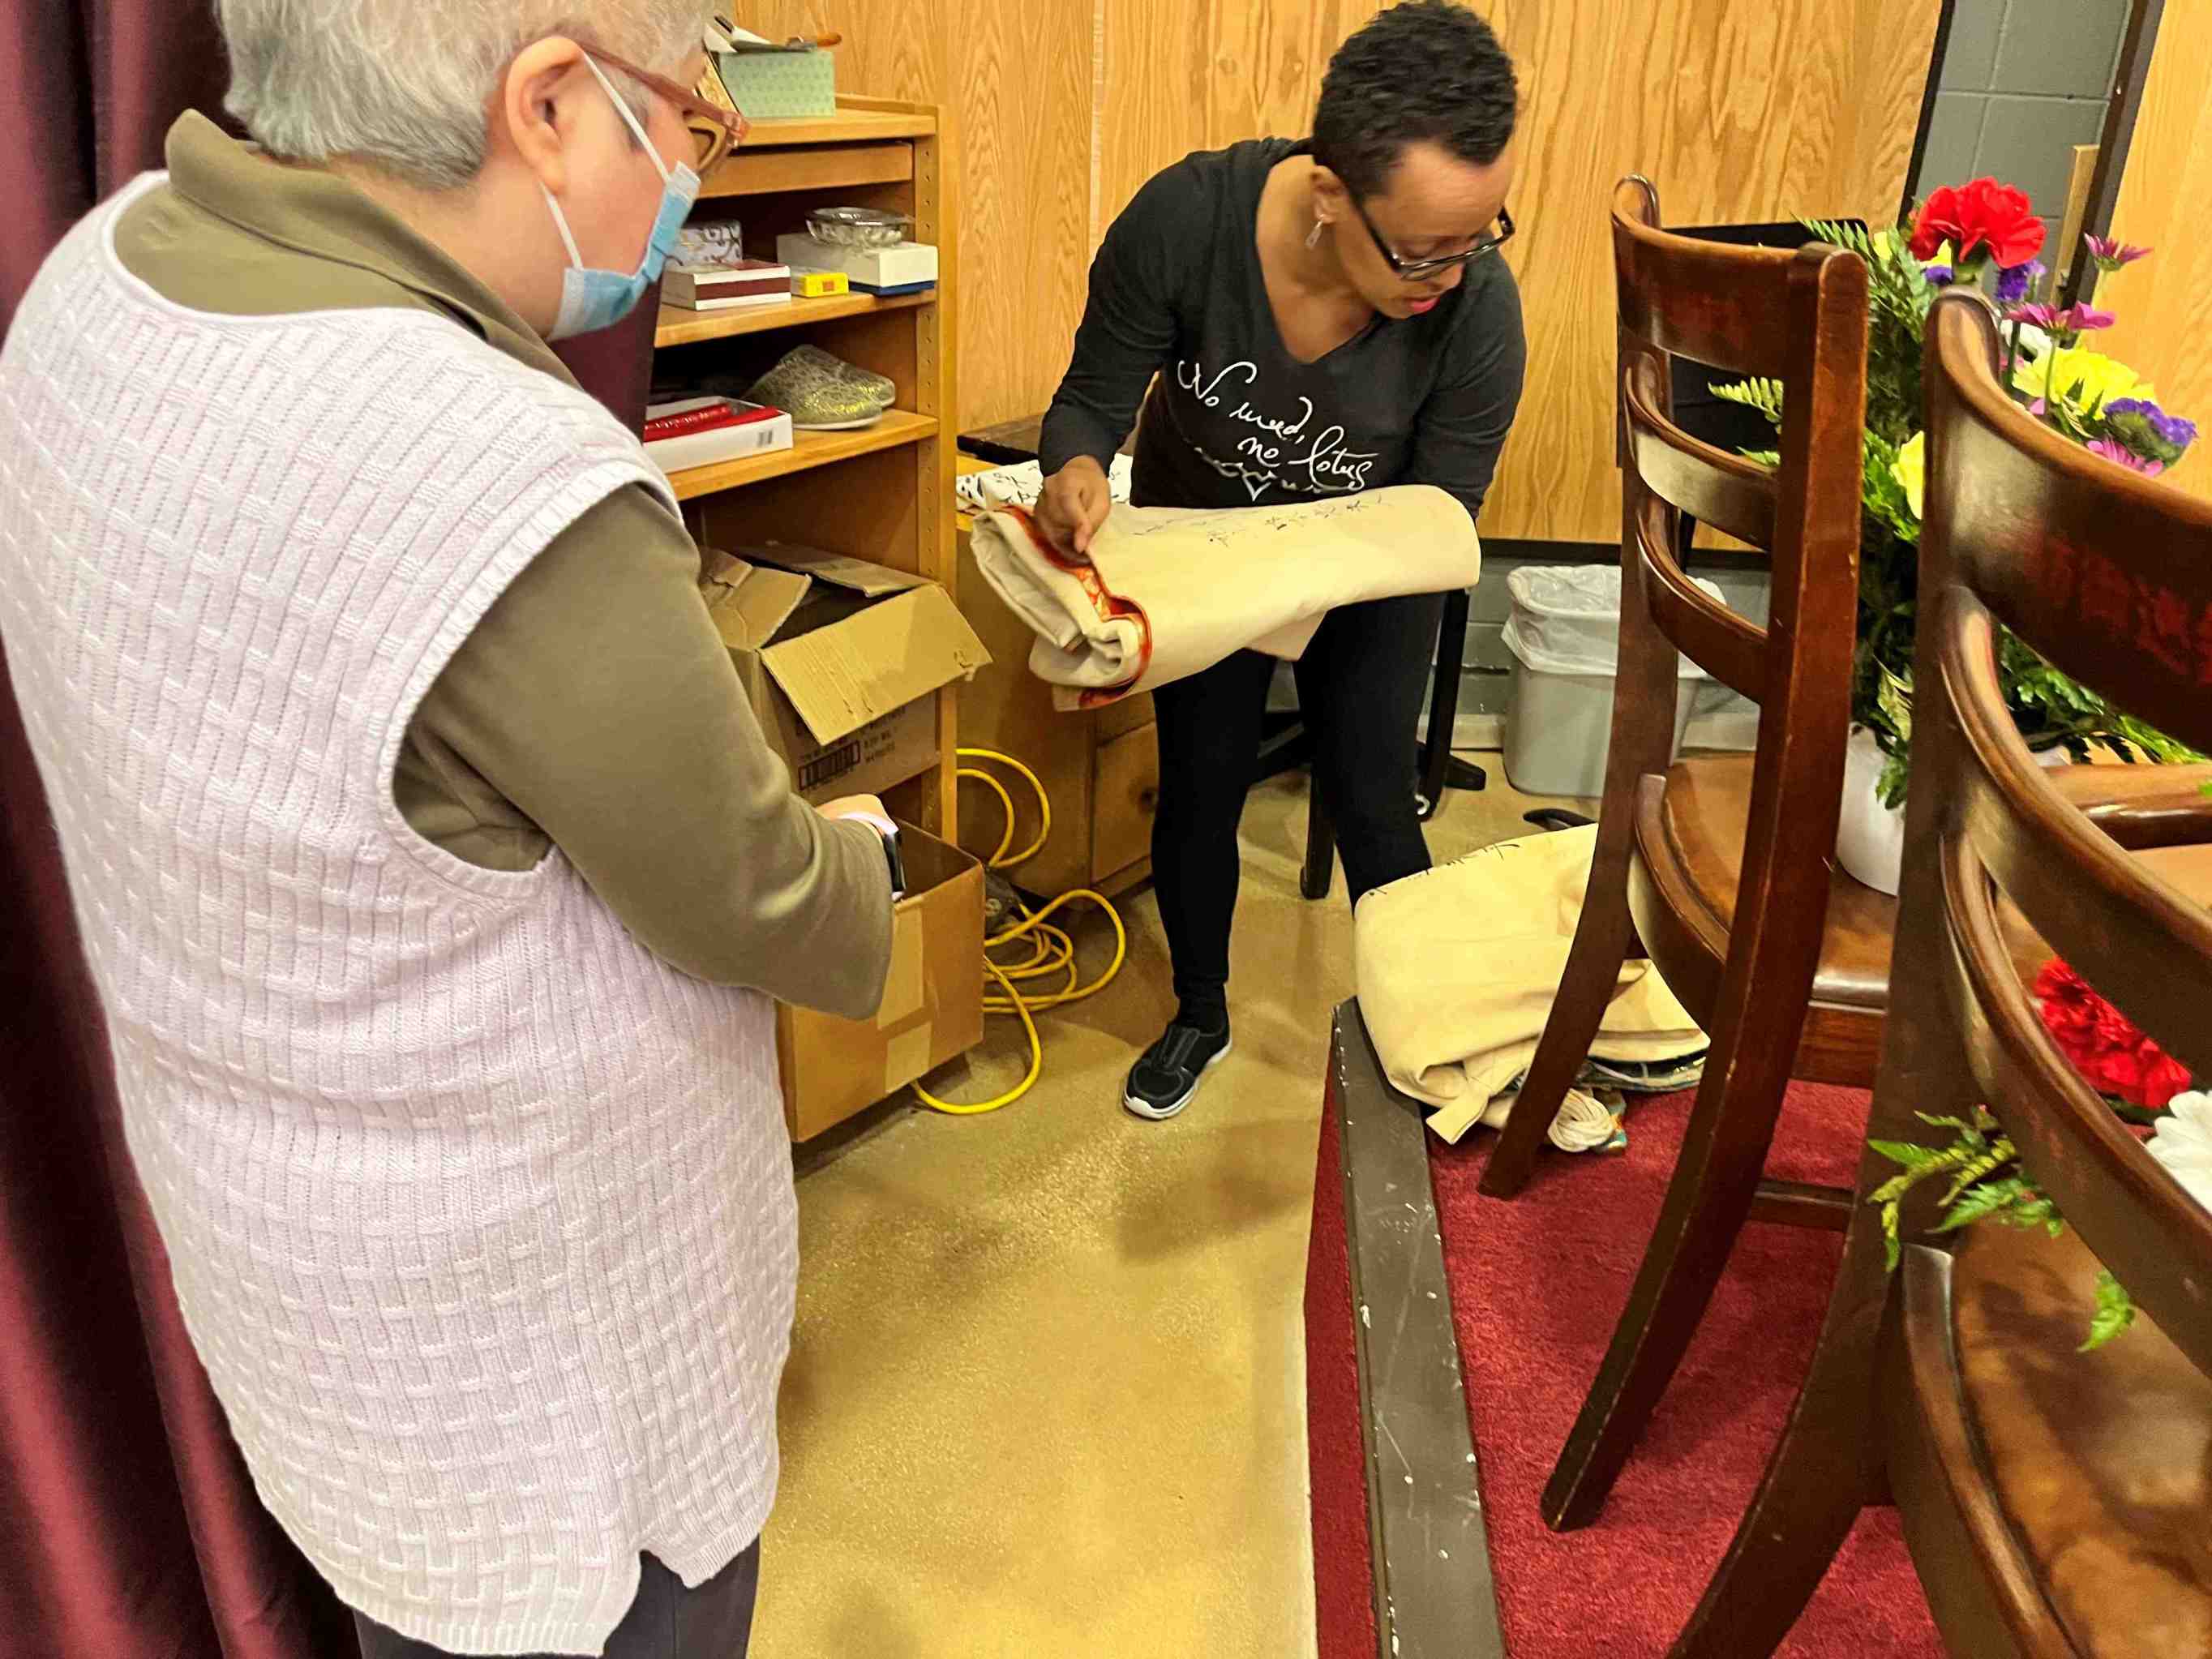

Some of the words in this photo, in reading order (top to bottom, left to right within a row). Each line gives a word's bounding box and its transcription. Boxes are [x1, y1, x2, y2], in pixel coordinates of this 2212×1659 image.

[1177, 360, 1258, 407] No
[1237, 436, 1281, 468] no
[1288, 425, 1379, 491] lotus
